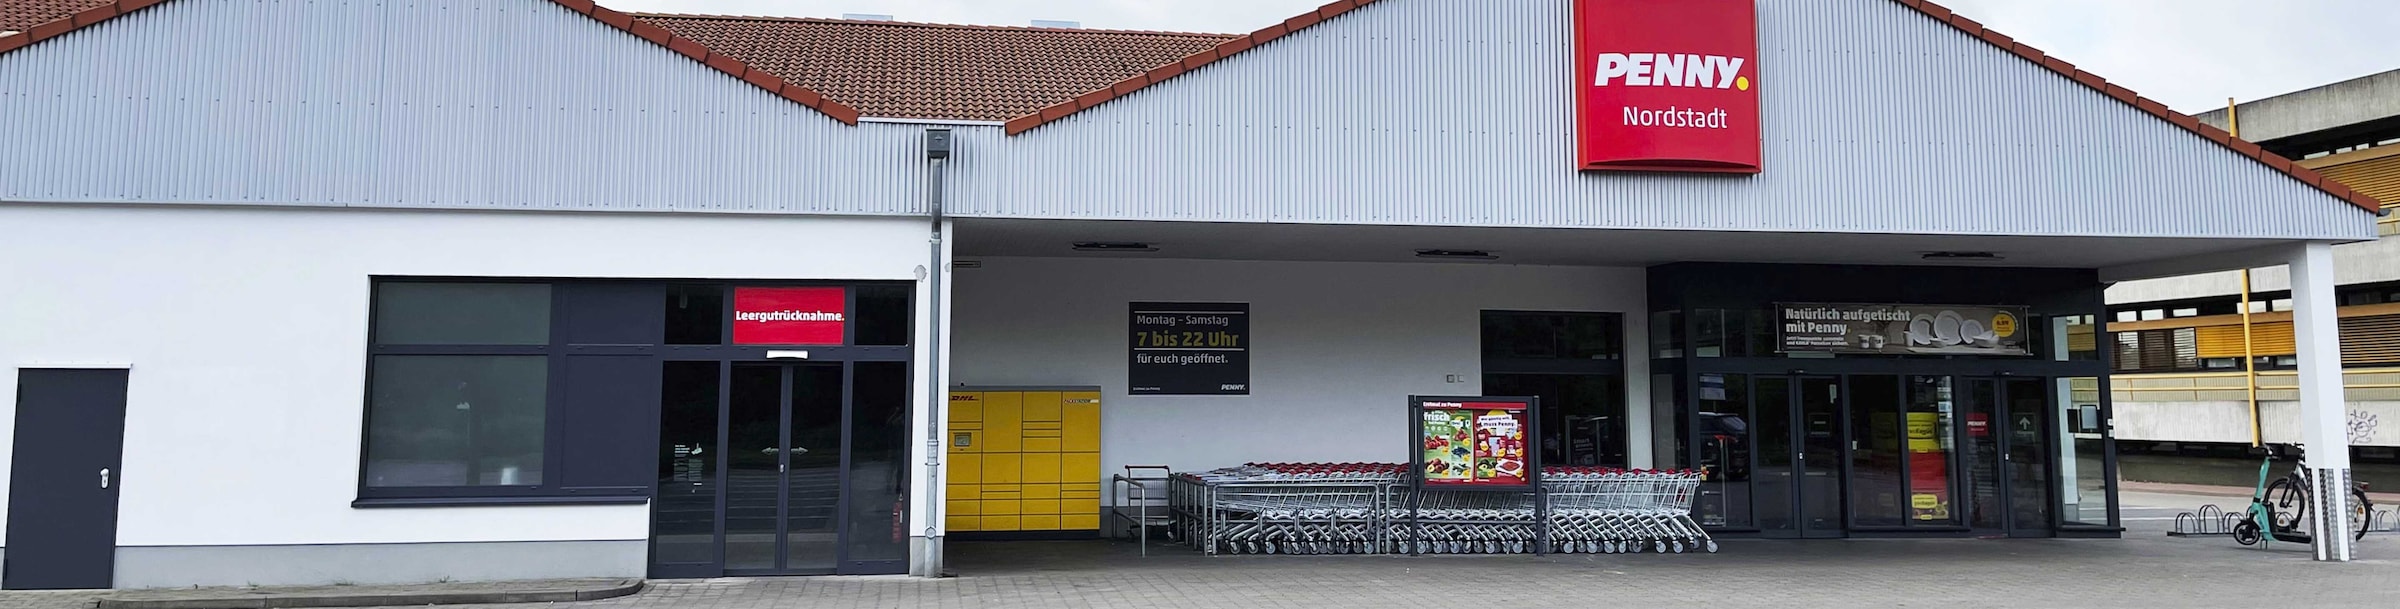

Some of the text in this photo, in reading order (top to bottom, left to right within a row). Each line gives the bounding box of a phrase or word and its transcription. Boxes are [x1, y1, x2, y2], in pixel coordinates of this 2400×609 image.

[1594, 52, 1749, 91] PENNY.
[1623, 106, 1728, 129] Nordstadt
[735, 310, 845, 323] Leergutrücknahme.
[1136, 315, 1176, 327] Montag
[1185, 315, 1229, 327] Samstag
[1785, 307, 1911, 323] Natürlich aufgetischt
[1785, 320, 1806, 333] mit
[1137, 330, 1239, 347] 7 bis 22 Uhr
[1136, 354, 1229, 366] für euch geöffnet.
[1424, 411, 1450, 421] frisch
